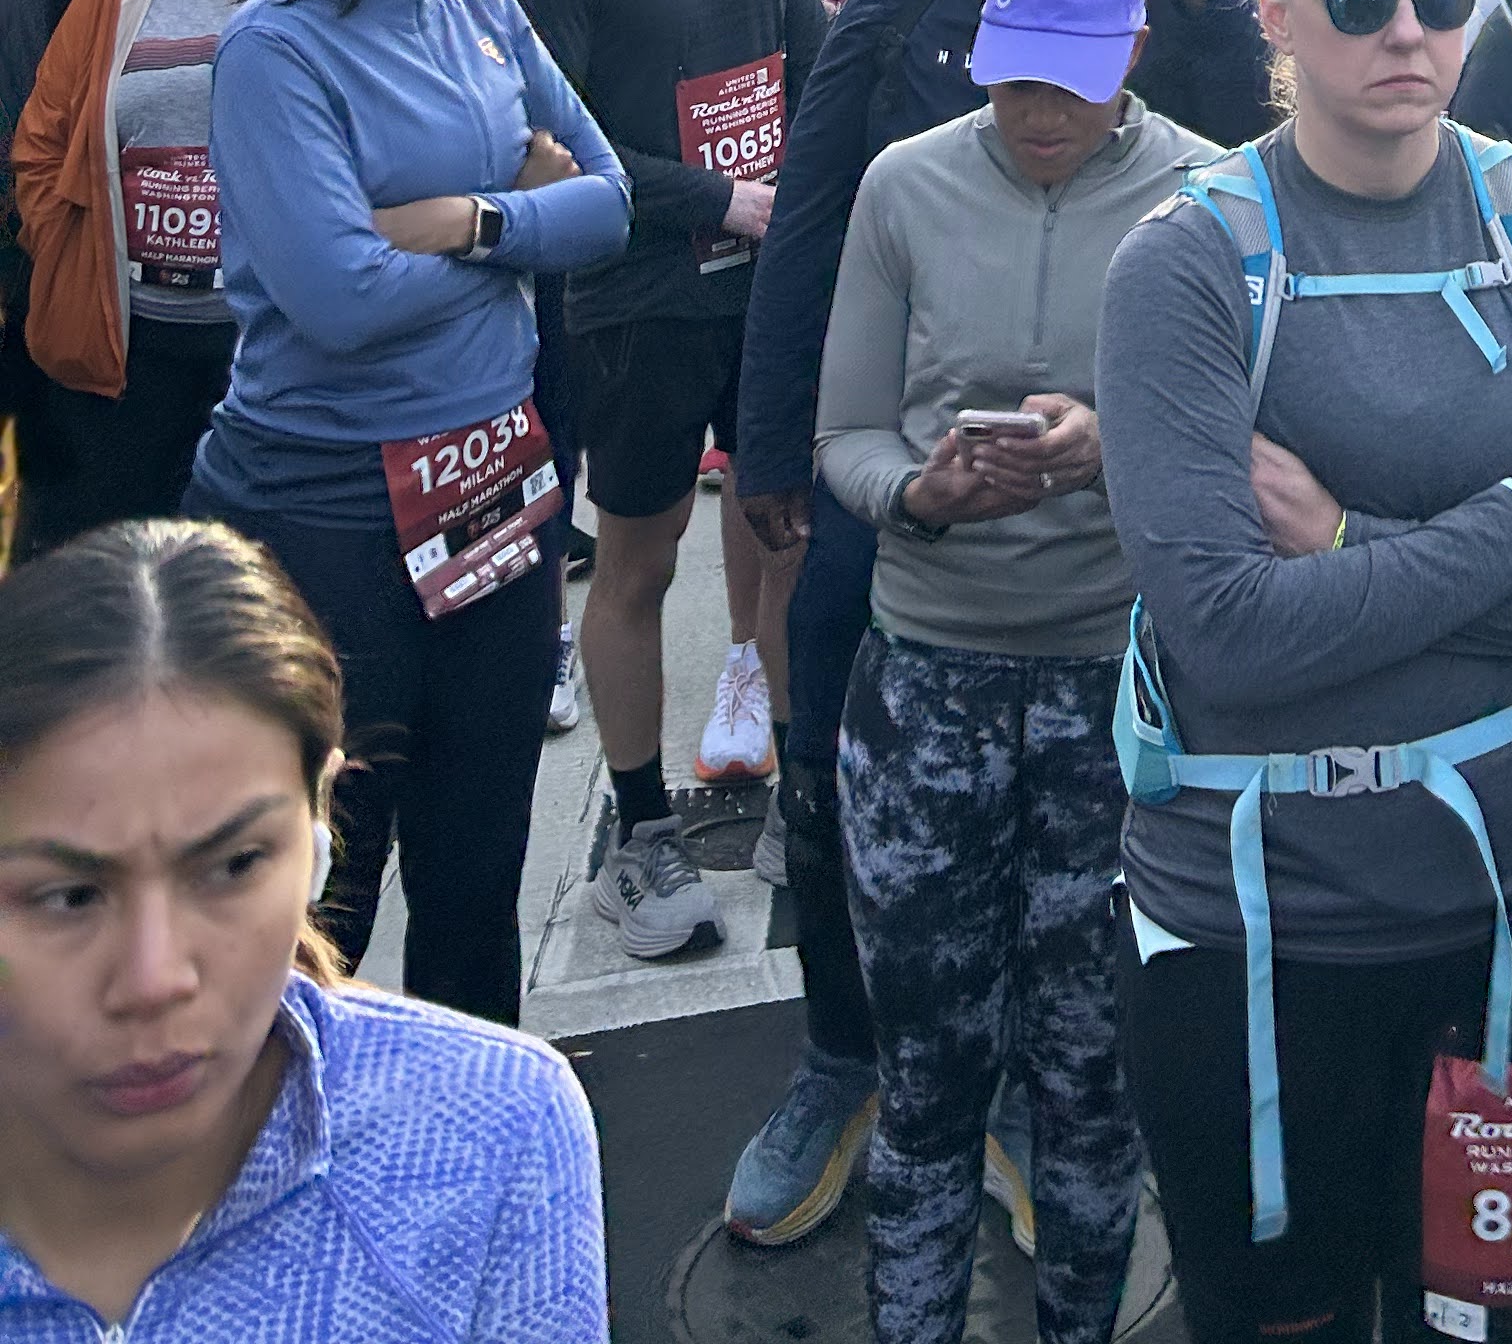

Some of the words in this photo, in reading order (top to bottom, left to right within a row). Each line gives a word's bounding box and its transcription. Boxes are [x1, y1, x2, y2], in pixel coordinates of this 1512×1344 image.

[718, 79, 756, 96] AIRLINES
[725, 72, 756, 87] UNITED
[690, 96, 742, 119] Rock
[753, 79, 781, 101] Roll
[702, 108, 749, 127] RUNNING
[750, 96, 777, 113] SERIES
[705, 110, 768, 134] WASHINGTON
[769, 105, 779, 115] DC
[698, 117, 783, 170] 10655
[723, 152, 775, 179] MATTHEW
[140, 180, 190, 192] RUNNING
[141, 189, 216, 201] WASHINGTON
[146, 234, 217, 250] KATHLEEN
[141, 252, 165, 260] HALF
[165, 253, 219, 264] MARATHON
[411, 405, 530, 495] 12038
[459, 455, 505, 495] MILAN
[438, 501, 470, 525] HALF
[470, 465, 524, 509] MARATHON
[616, 869, 645, 912] HOKA
[1458, 1313, 1471, 1328] 2
